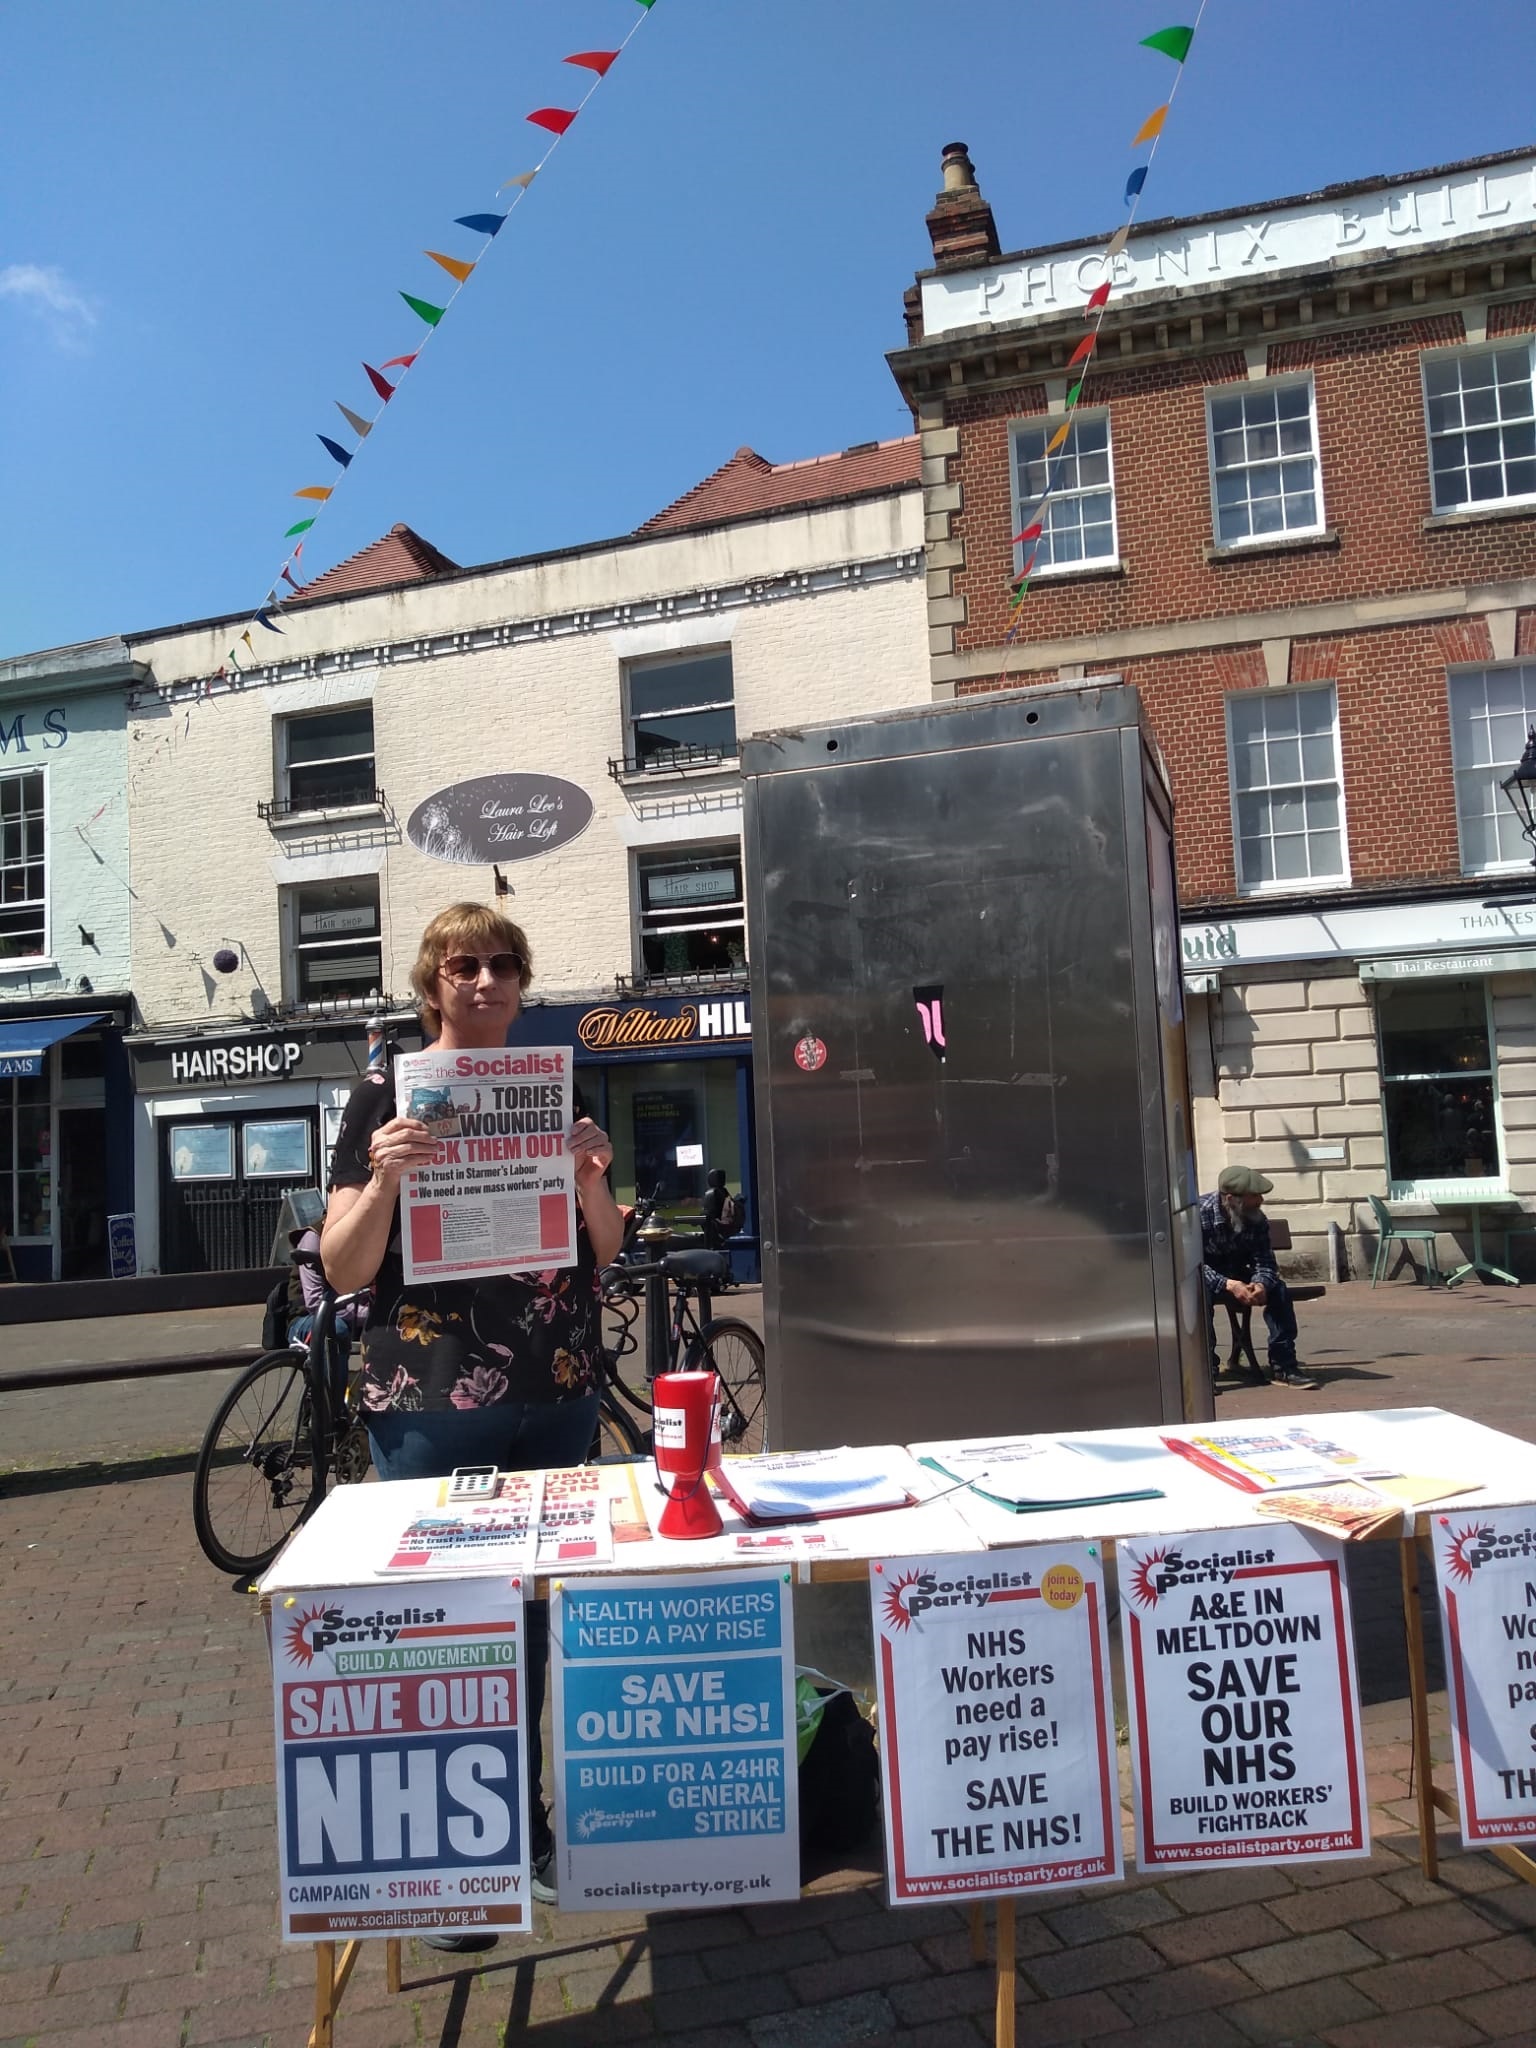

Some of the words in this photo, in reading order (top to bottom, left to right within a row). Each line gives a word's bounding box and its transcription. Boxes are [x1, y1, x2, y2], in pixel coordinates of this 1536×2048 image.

[1333, 166, 1536, 248] BUIL
[479, 800, 524, 819] Laura
[527, 794, 563, 813] Lee's
[488, 823, 524, 843] Hair
[527, 819, 557, 841] Loft
[1460, 915, 1499, 928] THAI
[1392, 962, 1420, 973] Thai
[1424, 957, 1494, 971] Restaurant
[578, 1004, 698, 1047] William
[699, 1001, 752, 1037] HIL
[455, 1053, 564, 1077] Socialist
[492, 1085, 563, 1110] TORIES
[460, 1110, 563, 1137] WOUNDED
[417, 1140, 461, 1166] CK
[465, 1135, 521, 1163] THEM
[525, 1134, 564, 1158] OUT
[418, 1172, 430, 1182] No
[431, 1171, 454, 1181] trust
[456, 1171, 464, 1180] in
[466, 1166, 508, 1179] Starmer's
[510, 1164, 538, 1176] Labour
[418, 1187, 431, 1199] We
[434, 1186, 455, 1198] need
[457, 1187, 462, 1196] a
[464, 1185, 481, 1196] new
[483, 1183, 505, 1194] mass
[507, 1178, 542, 1191] workers'
[543, 1176, 565, 1190] party
[1163, 1549, 1275, 1573] Socialist
[916, 1572, 1032, 1595] Socialist
[1065, 1575, 1079, 1586] us
[569, 1601, 653, 1622] HEALTH
[661, 1592, 775, 1619] WORKERS
[1050, 1589, 1077, 1603] today
[1189, 1590, 1247, 1621] A&E
[1254, 1586, 1284, 1615] IN
[321, 1606, 446, 1631] Socialist
[579, 1626, 639, 1647] NEED
[645, 1626, 660, 1644] A
[668, 1623, 709, 1643] PAY
[717, 1619, 766, 1640] RISE
[967, 1628, 1026, 1659] NHS
[1156, 1615, 1321, 1655] MELTDOWN
[339, 1651, 384, 1672] BUILD
[389, 1650, 399, 1669] A
[403, 1645, 490, 1668] MOVEMENT
[492, 1643, 513, 1663] TO
[621, 1670, 725, 1706] SAVE
[941, 1663, 1054, 1694] Workers
[1187, 1653, 1300, 1702] SAVE
[290, 1683, 402, 1735] SAVE
[418, 1676, 510, 1727] OUR
[955, 1694, 1021, 1725] need
[1030, 1697, 1045, 1717] a
[577, 1709, 662, 1741] OUR
[676, 1702, 770, 1737] NHS!
[1201, 1699, 1292, 1744] OUR
[946, 1736, 994, 1765] pay
[1000, 1721, 1058, 1753] rise!
[580, 1766, 646, 1787] BUILD
[653, 1763, 695, 1782] FOR
[701, 1761, 715, 1780] A
[721, 1757, 780, 1779] 24HR
[1203, 1741, 1296, 1787] NHS
[296, 1743, 511, 1865] NHS
[668, 1781, 781, 1809] GENERAL
[966, 1772, 1048, 1811] SAVE
[1170, 1794, 1228, 1816] BUILD
[596, 1809, 656, 1822] Socialist
[694, 1808, 781, 1834] STRIKE
[1198, 1809, 1308, 1834] FIGHTBACK
[931, 1824, 995, 1859] THE
[1003, 1813, 1081, 1852] NHS!
[1154, 1834, 1353, 1860] www.socialistparty.org.uk
[289, 1883, 370, 1903] CAMPAIGN
[388, 1879, 442, 1898] STRIKE
[459, 1875, 521, 1895] OCCUPY
[584, 1874, 771, 1899] socialistparty.org.uk
[906, 1859, 1106, 1893] www.socialistparty.org.uk
[329, 1907, 488, 1928] www.socialistparty.org.uk
